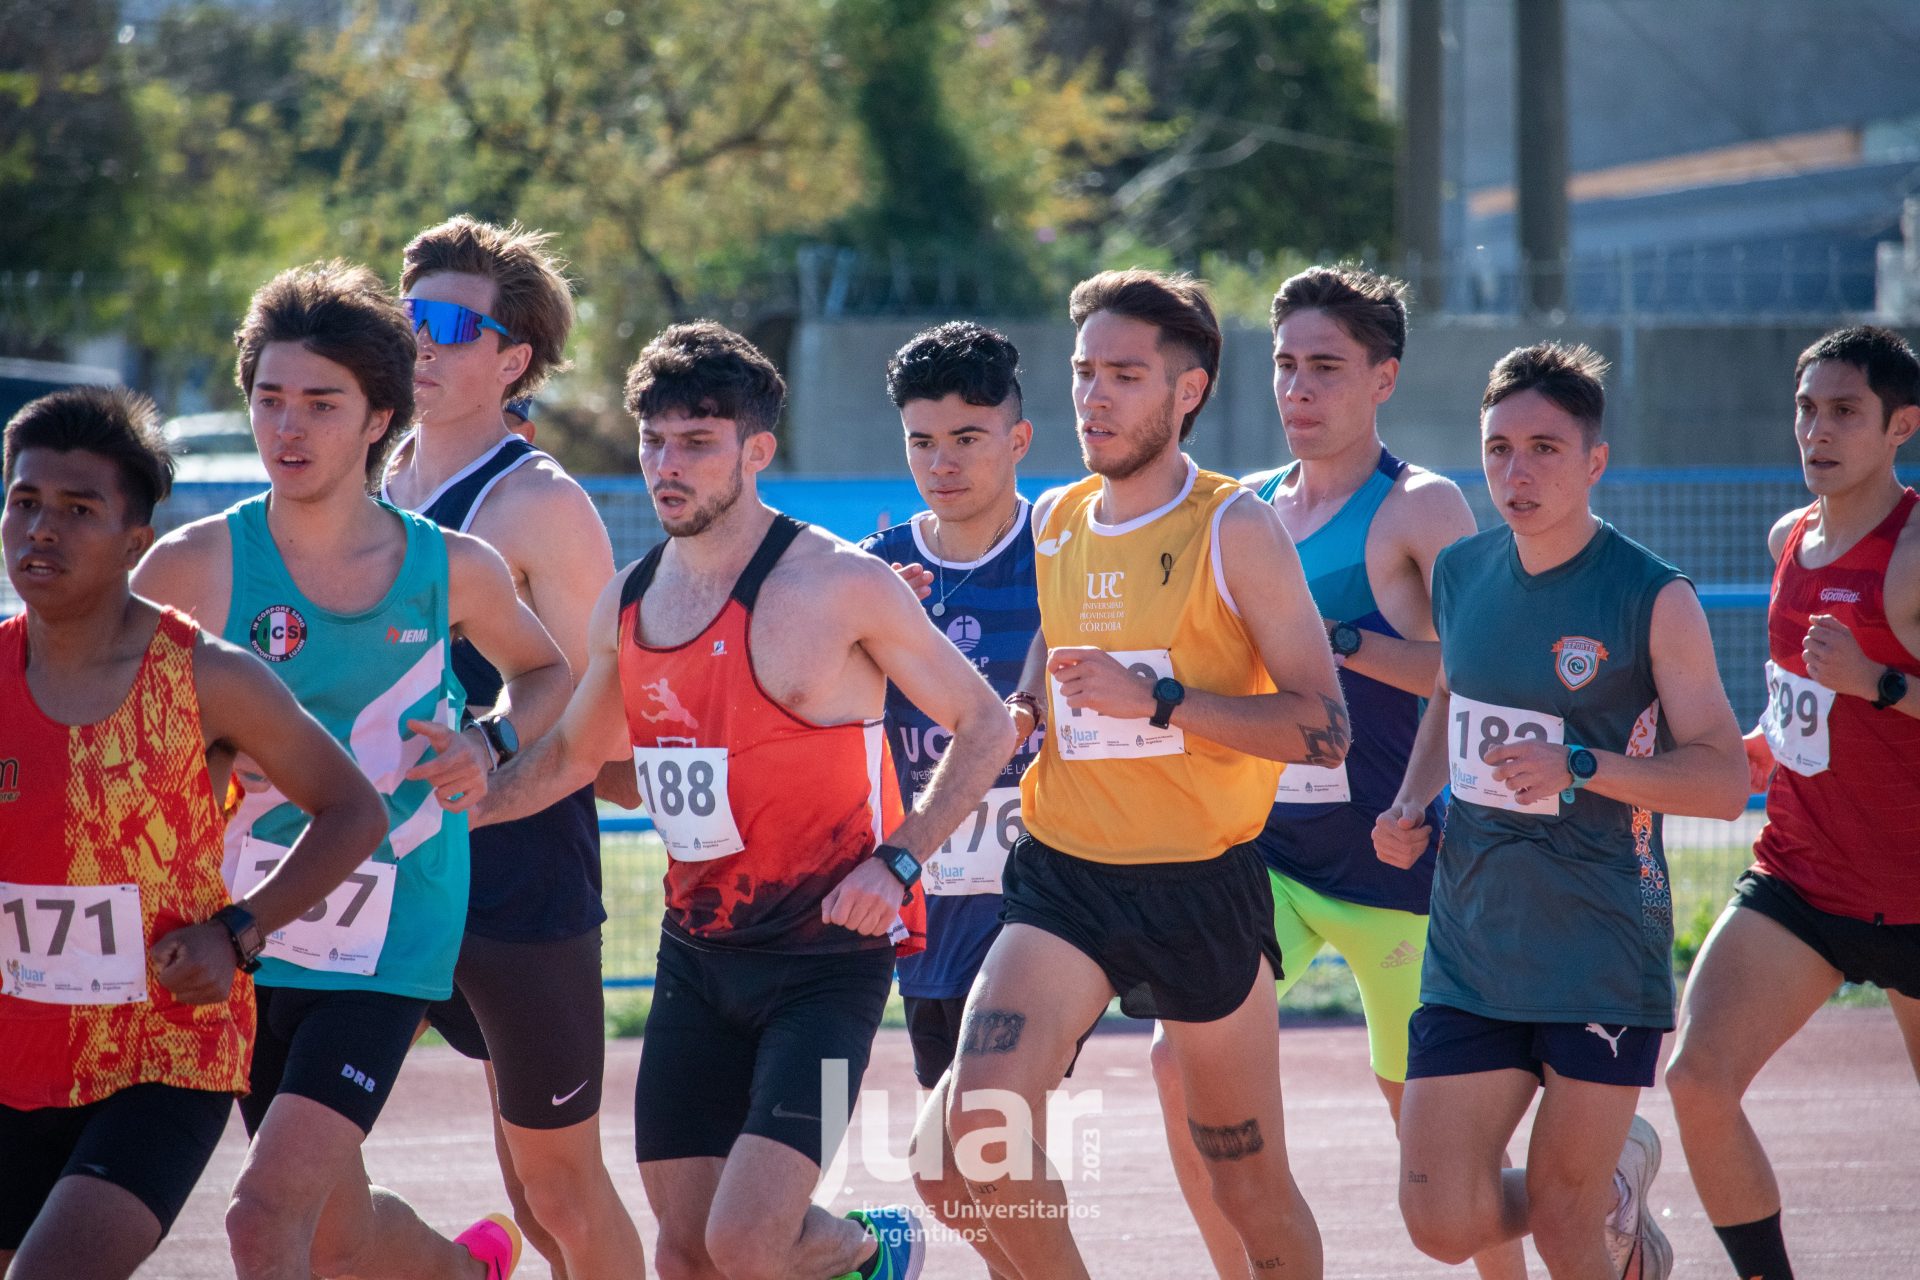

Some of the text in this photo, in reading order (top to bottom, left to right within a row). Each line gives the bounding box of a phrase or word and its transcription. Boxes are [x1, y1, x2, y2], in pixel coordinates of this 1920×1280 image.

[257, 606, 290, 621] CORPORE
[291, 610, 305, 628] SANO
[251, 640, 280, 661] DEPORTES
[638, 760, 716, 817] 188
[2, 898, 116, 956] 171
[341, 1063, 376, 1093] DRB
